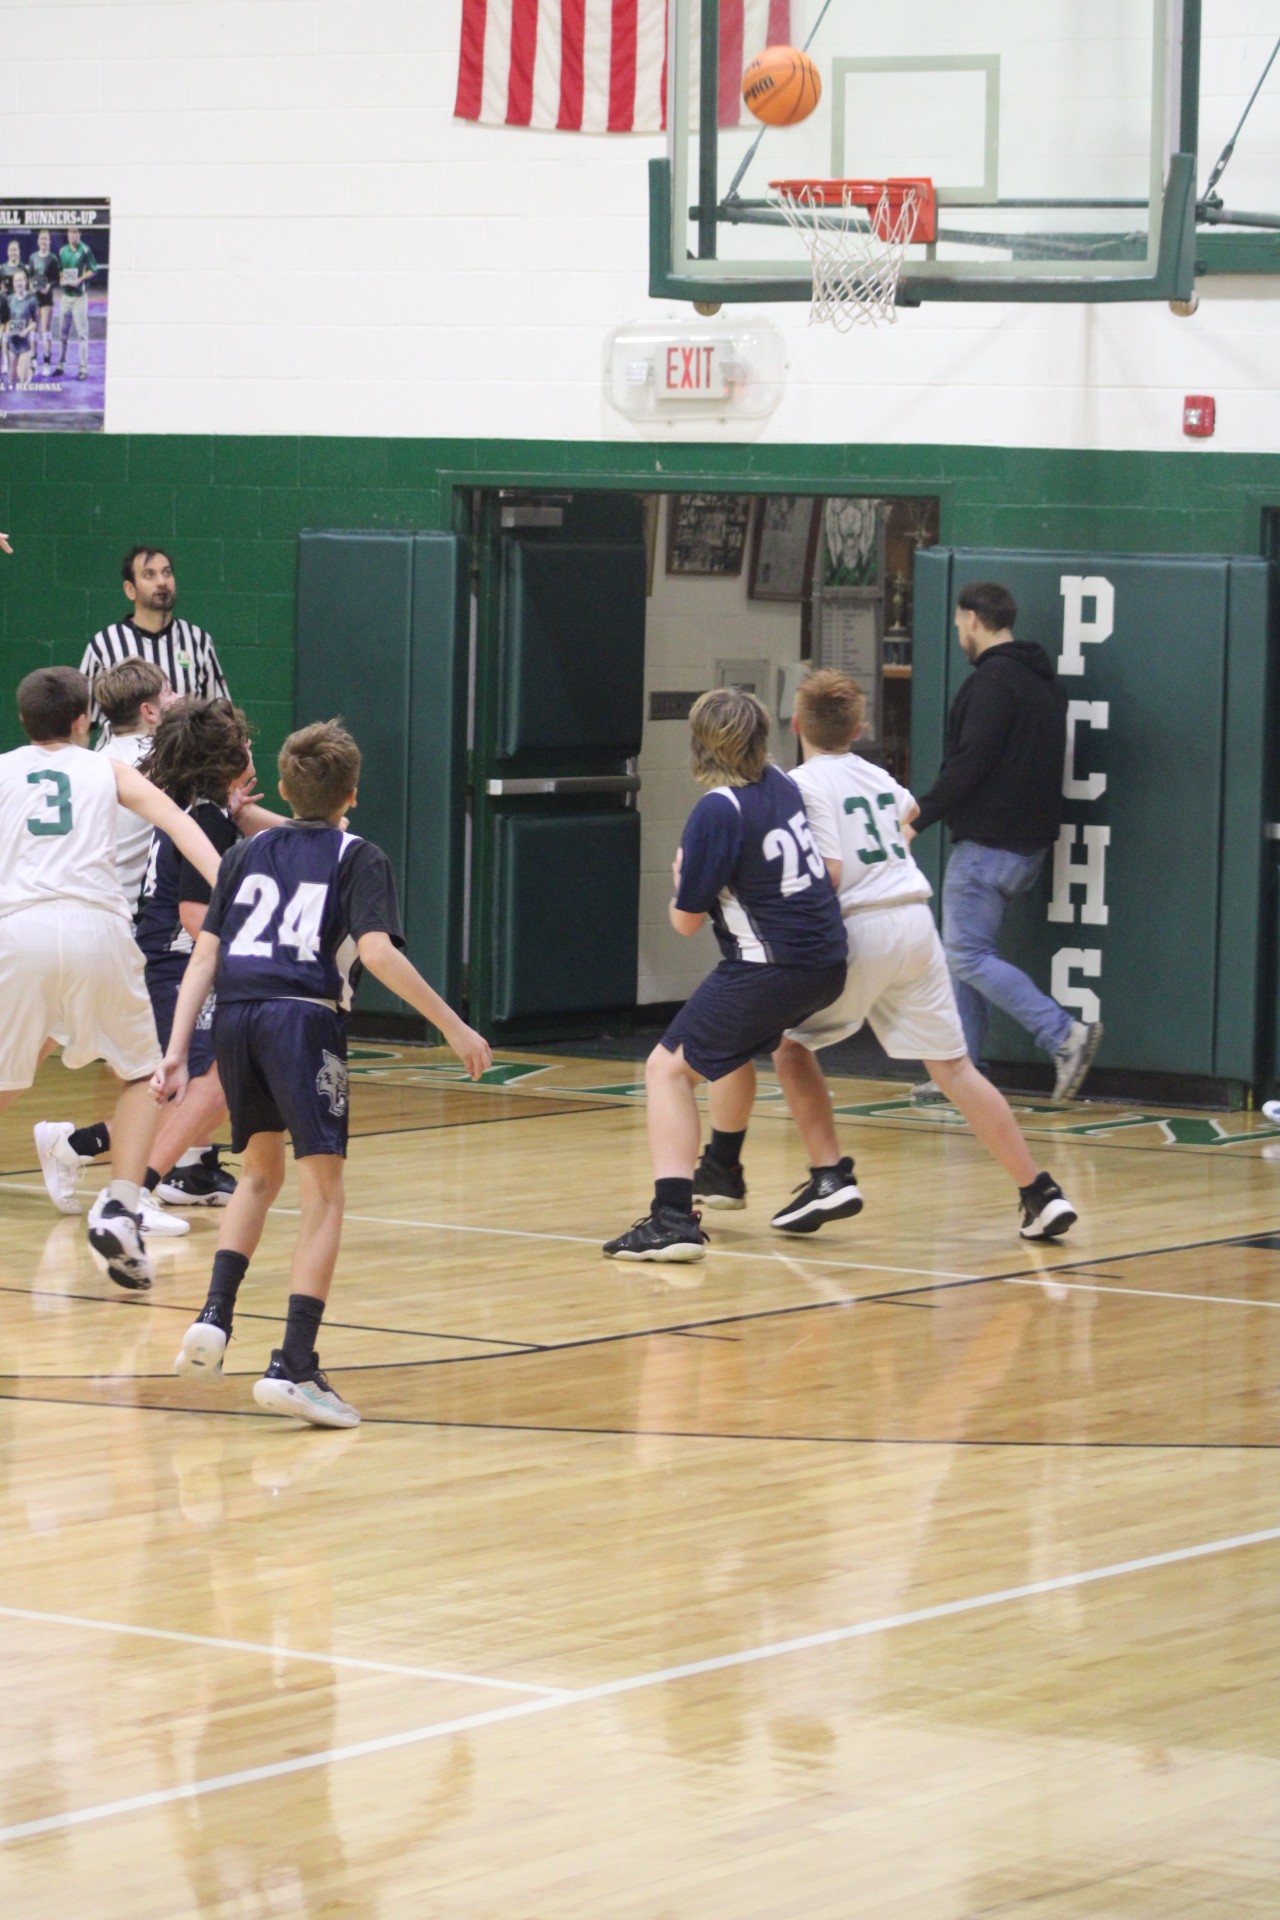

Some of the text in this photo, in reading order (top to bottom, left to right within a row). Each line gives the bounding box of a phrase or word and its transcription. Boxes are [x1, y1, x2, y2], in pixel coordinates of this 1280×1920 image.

[24, 210, 97, 225] RUNNERS-UP
[666, 347, 715, 389] EXIT
[26, 768, 74, 836] 3
[762, 811, 826, 898] 25
[227, 873, 329, 963] 24
